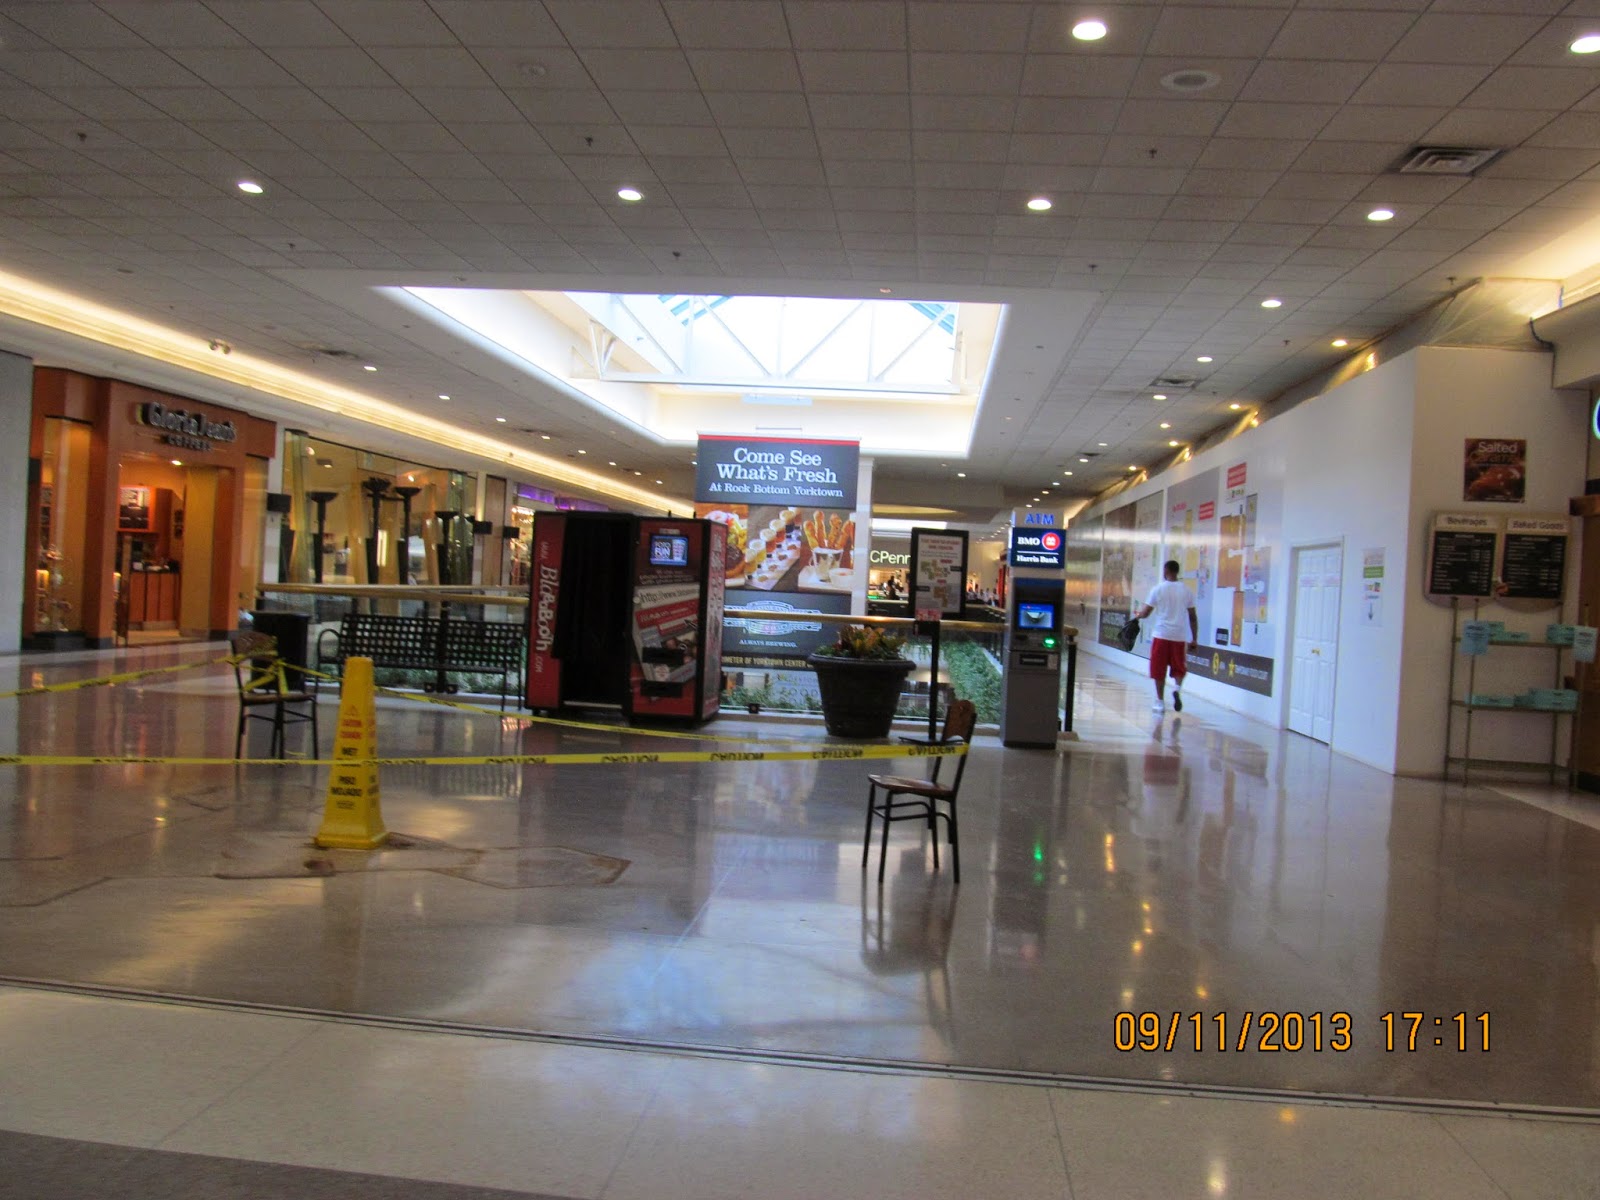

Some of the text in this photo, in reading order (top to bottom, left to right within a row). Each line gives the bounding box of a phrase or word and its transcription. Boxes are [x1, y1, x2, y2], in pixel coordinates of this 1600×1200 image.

[1478, 441, 1518, 453] Salted
[733, 447, 822, 466] Come See
[716, 463, 838, 484] What's Fresh
[709, 482, 843, 498] At Rock Bottom Yorktown
[1025, 513, 1054, 525] ATM
[1513, 520, 1537, 529] Baked
[1017, 536, 1040, 546] BMO
[1016, 555, 1059, 564] Harris Bank
